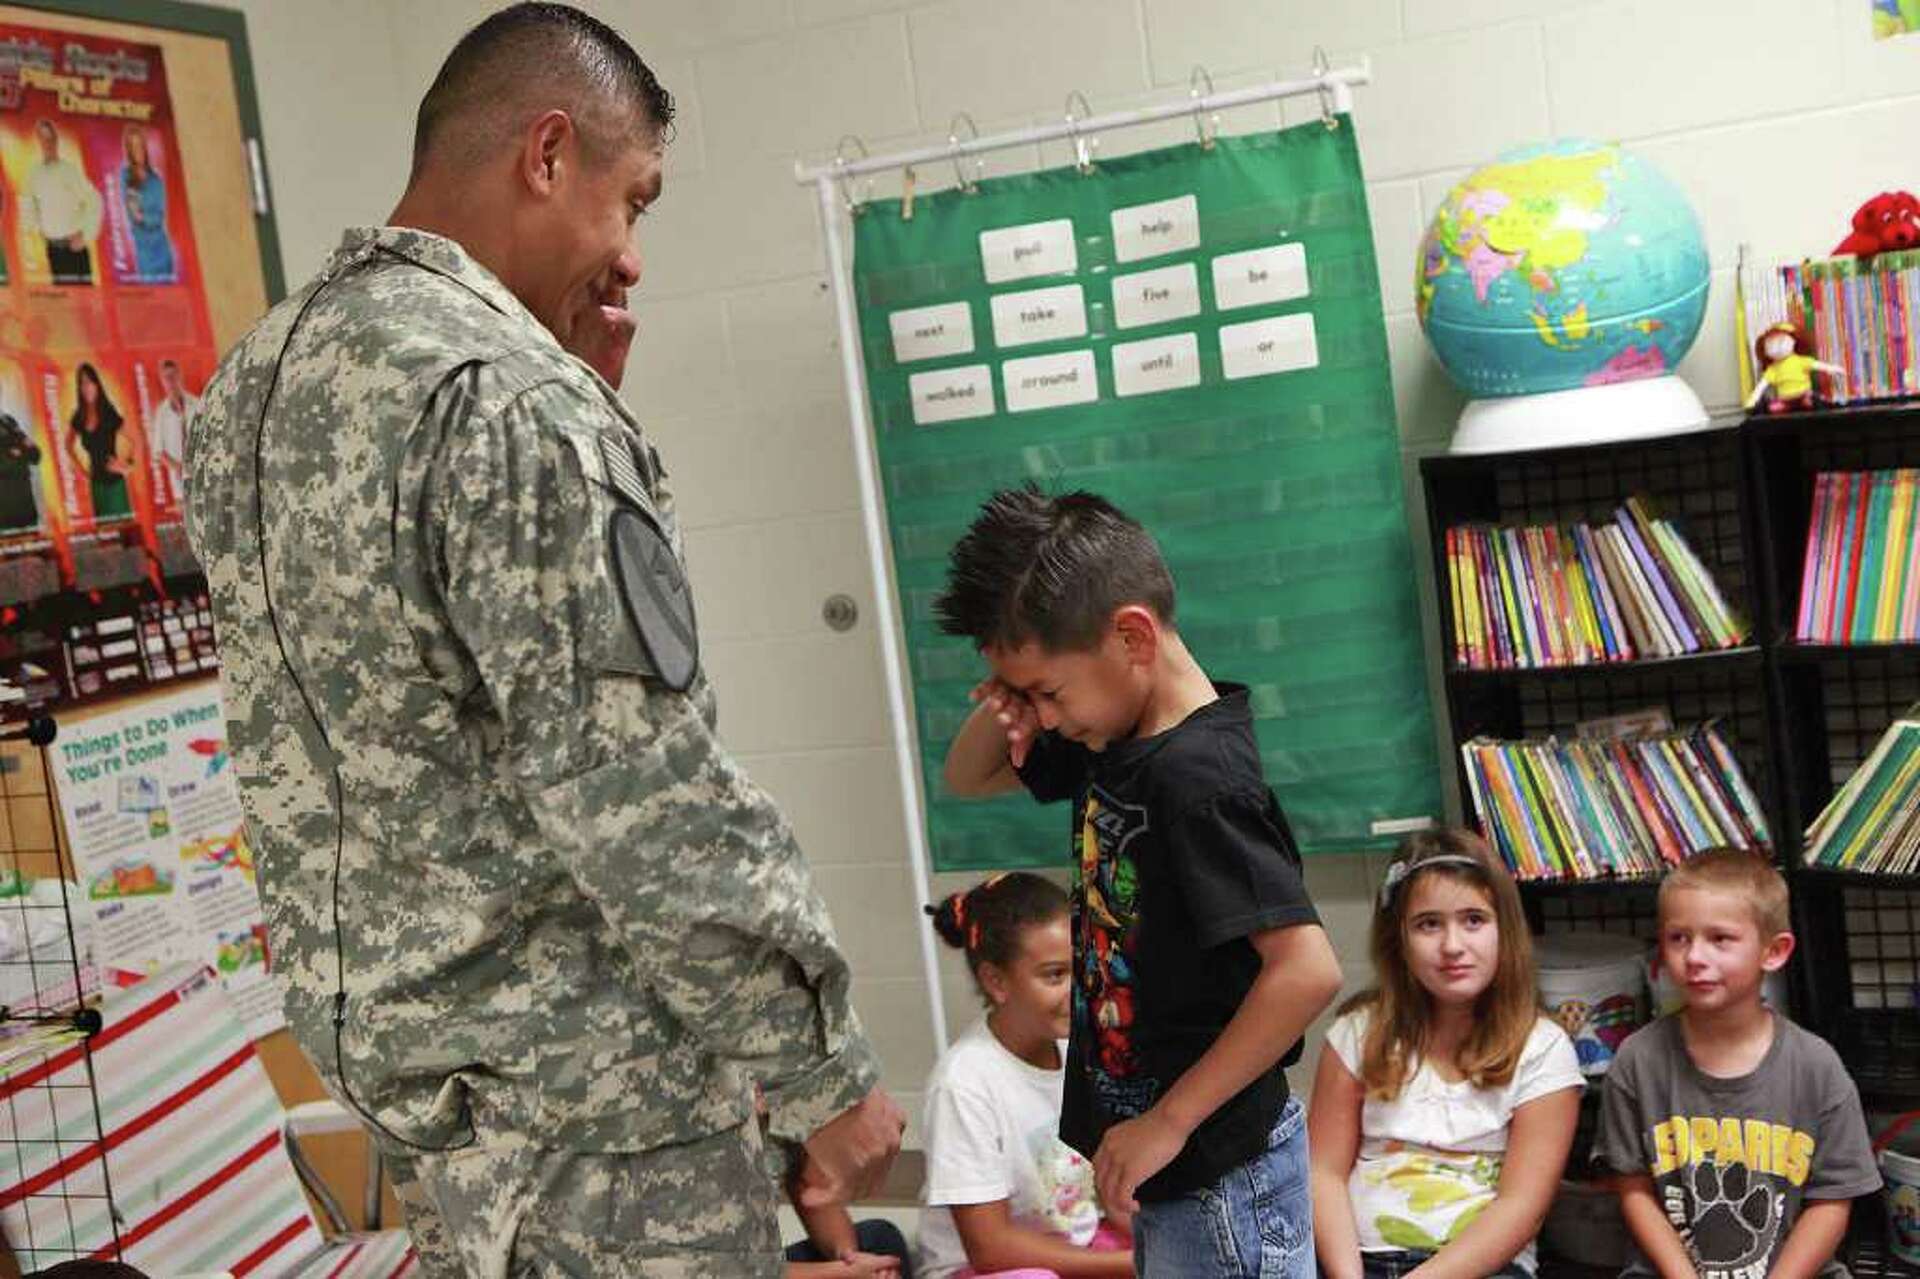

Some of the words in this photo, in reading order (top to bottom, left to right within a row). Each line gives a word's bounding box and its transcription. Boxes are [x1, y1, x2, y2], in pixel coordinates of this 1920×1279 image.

[58, 91, 152, 118] Character
[1140, 220, 1172, 239] help
[1248, 269, 1269, 283] be
[1143, 288, 1170, 303] five
[1020, 307, 1056, 323] take
[914, 324, 945, 338] next
[1256, 340, 1275, 353] or
[1140, 354, 1173, 372] until
[1021, 368, 1079, 390] around
[926, 383, 976, 402] walked
[61, 731, 121, 762] Things
[123, 725, 143, 743] to
[147, 718, 169, 736] Do
[171, 704, 220, 728] When
[66, 756, 122, 784] You're
[126, 741, 168, 767] Done
